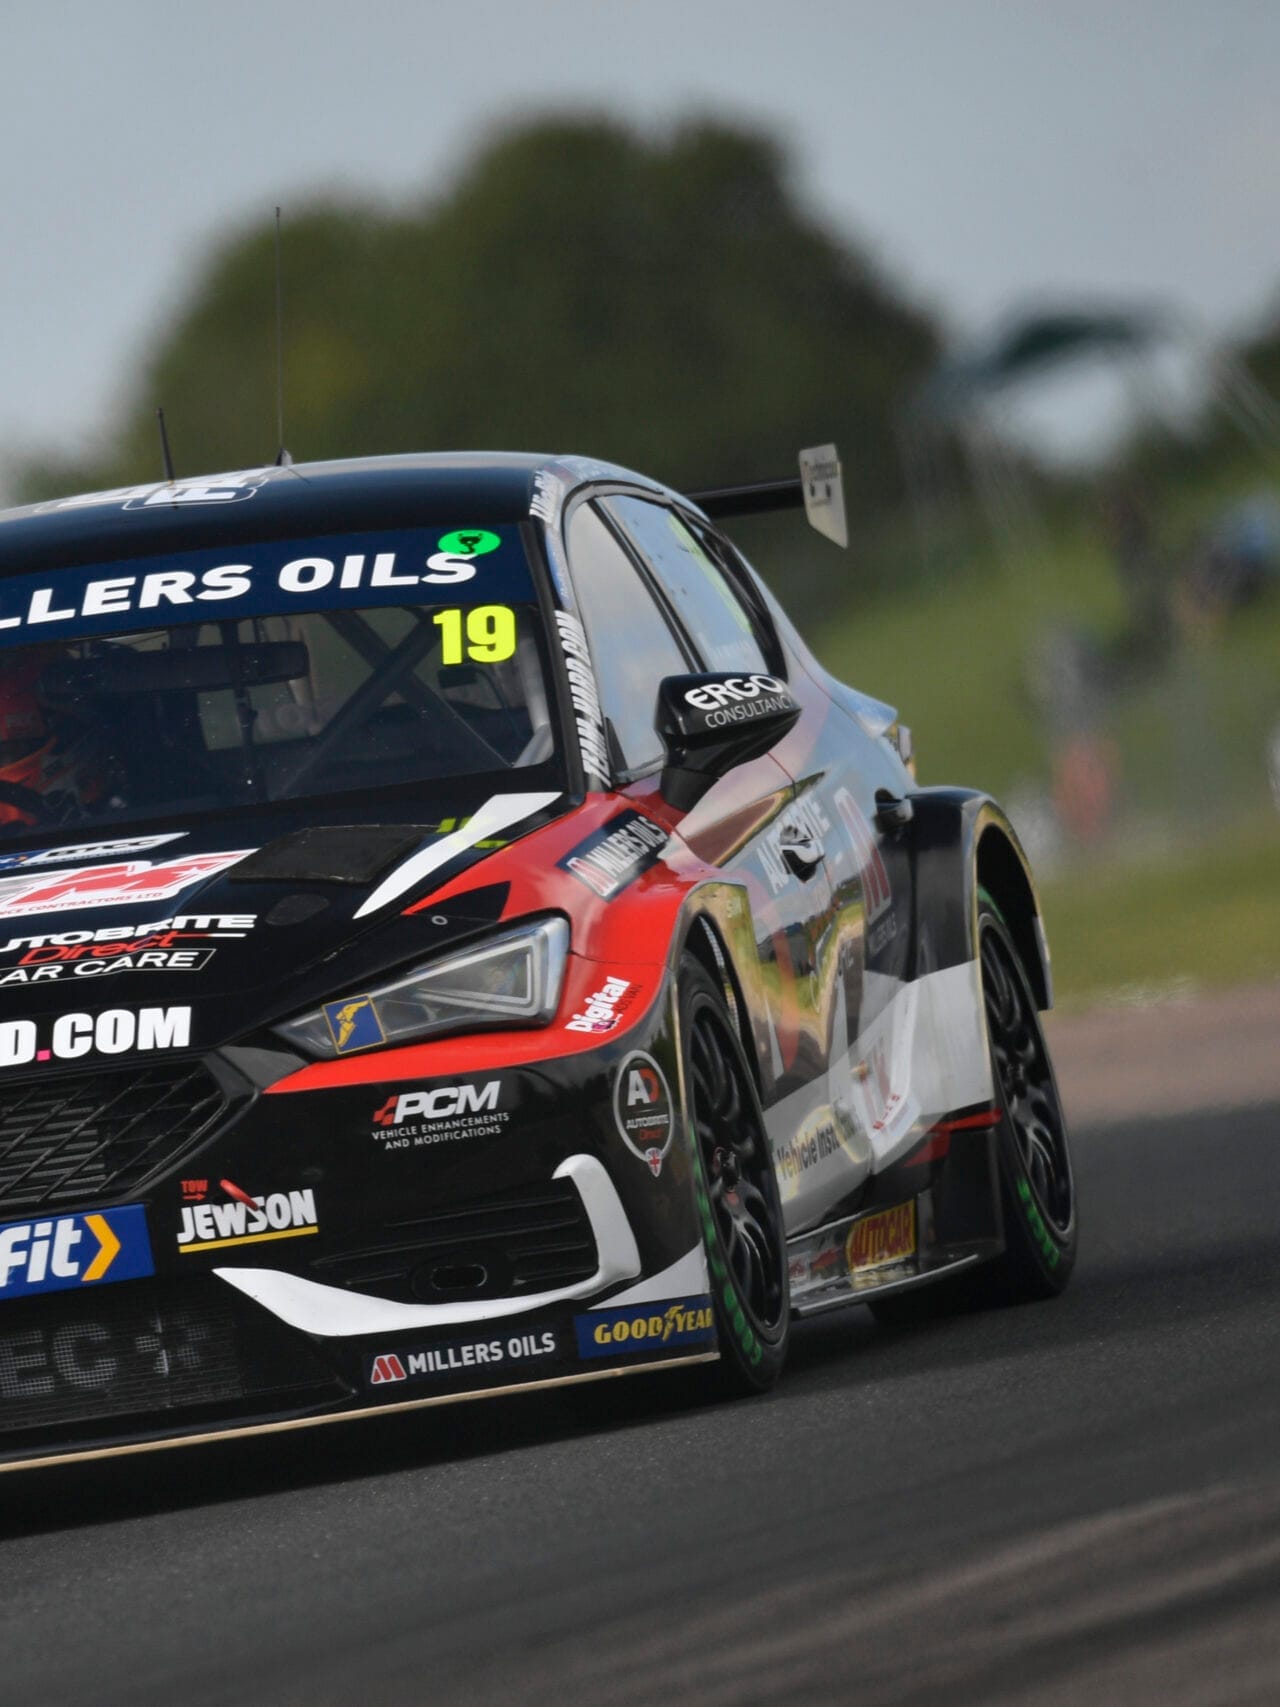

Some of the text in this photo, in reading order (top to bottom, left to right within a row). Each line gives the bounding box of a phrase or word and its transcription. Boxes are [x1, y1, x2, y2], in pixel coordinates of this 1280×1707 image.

[278, 550, 479, 593] OILS
[432, 605, 516, 664] 19
[684, 675, 784, 710] ERGO
[19, 930, 190, 965] Direct
[74, 951, 200, 974] CARE
[565, 976, 631, 1032] Digital
[394, 1080, 501, 1124] PCM
[372, 1112, 510, 1141] VEHICLE ENHANCEMENTS
[385, 1125, 502, 1150] AND MODIFICATIONS
[180, 1179, 208, 1193] TOW
[177, 1189, 318, 1243] JEWSON
[408, 1332, 556, 1375] MILLERS OILS
